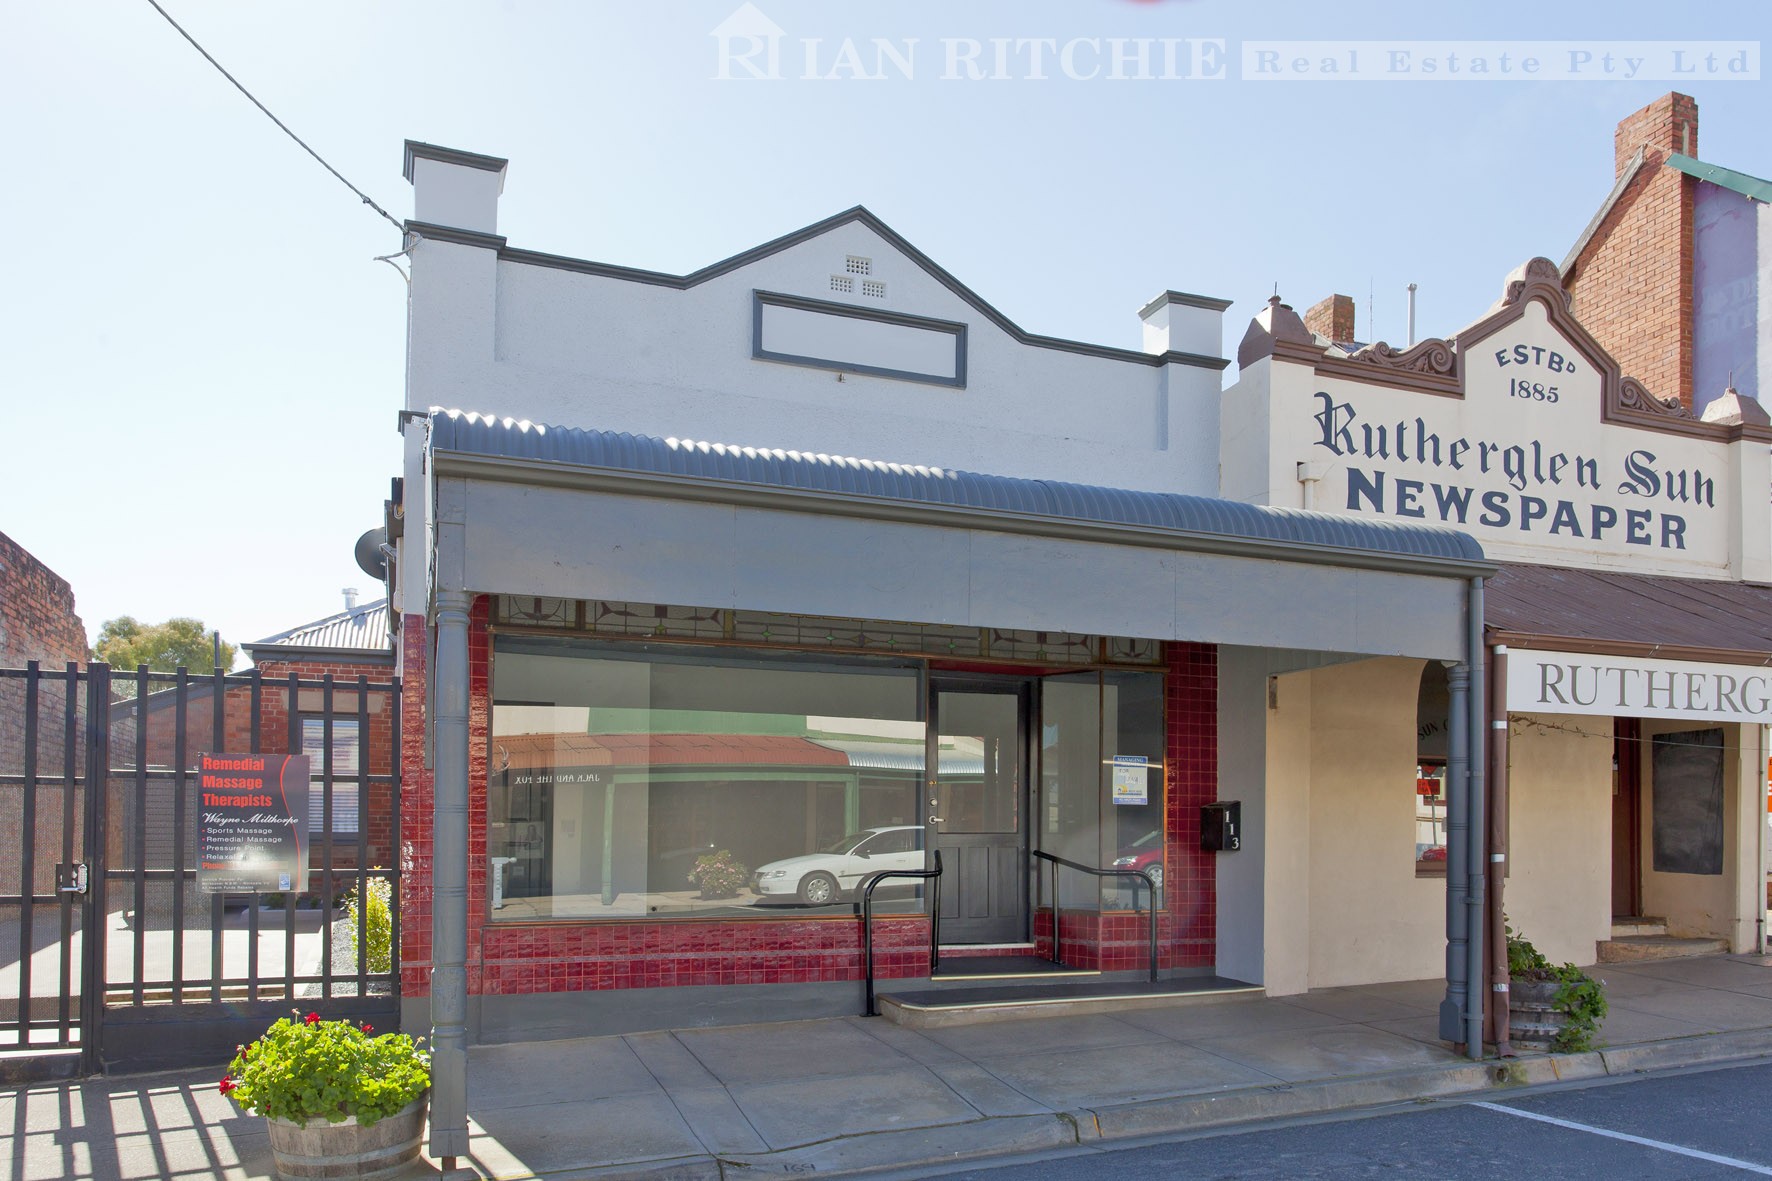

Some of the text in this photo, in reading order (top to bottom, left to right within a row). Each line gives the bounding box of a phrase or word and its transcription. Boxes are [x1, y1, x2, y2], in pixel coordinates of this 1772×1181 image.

[1509, 377, 1560, 404] 1885
[1313, 391, 1715, 509] Rutherglen Sun
[1346, 466, 1687, 550] NEWSPAPER
[1536, 662, 1772, 715] RUTHERG
[203, 757, 265, 771] Remedial
[203, 776, 263, 790] Massage
[203, 793, 272, 808] Therapists
[202, 813, 299, 826] Wayne Milthorpe
[206, 827, 234, 835] Sports
